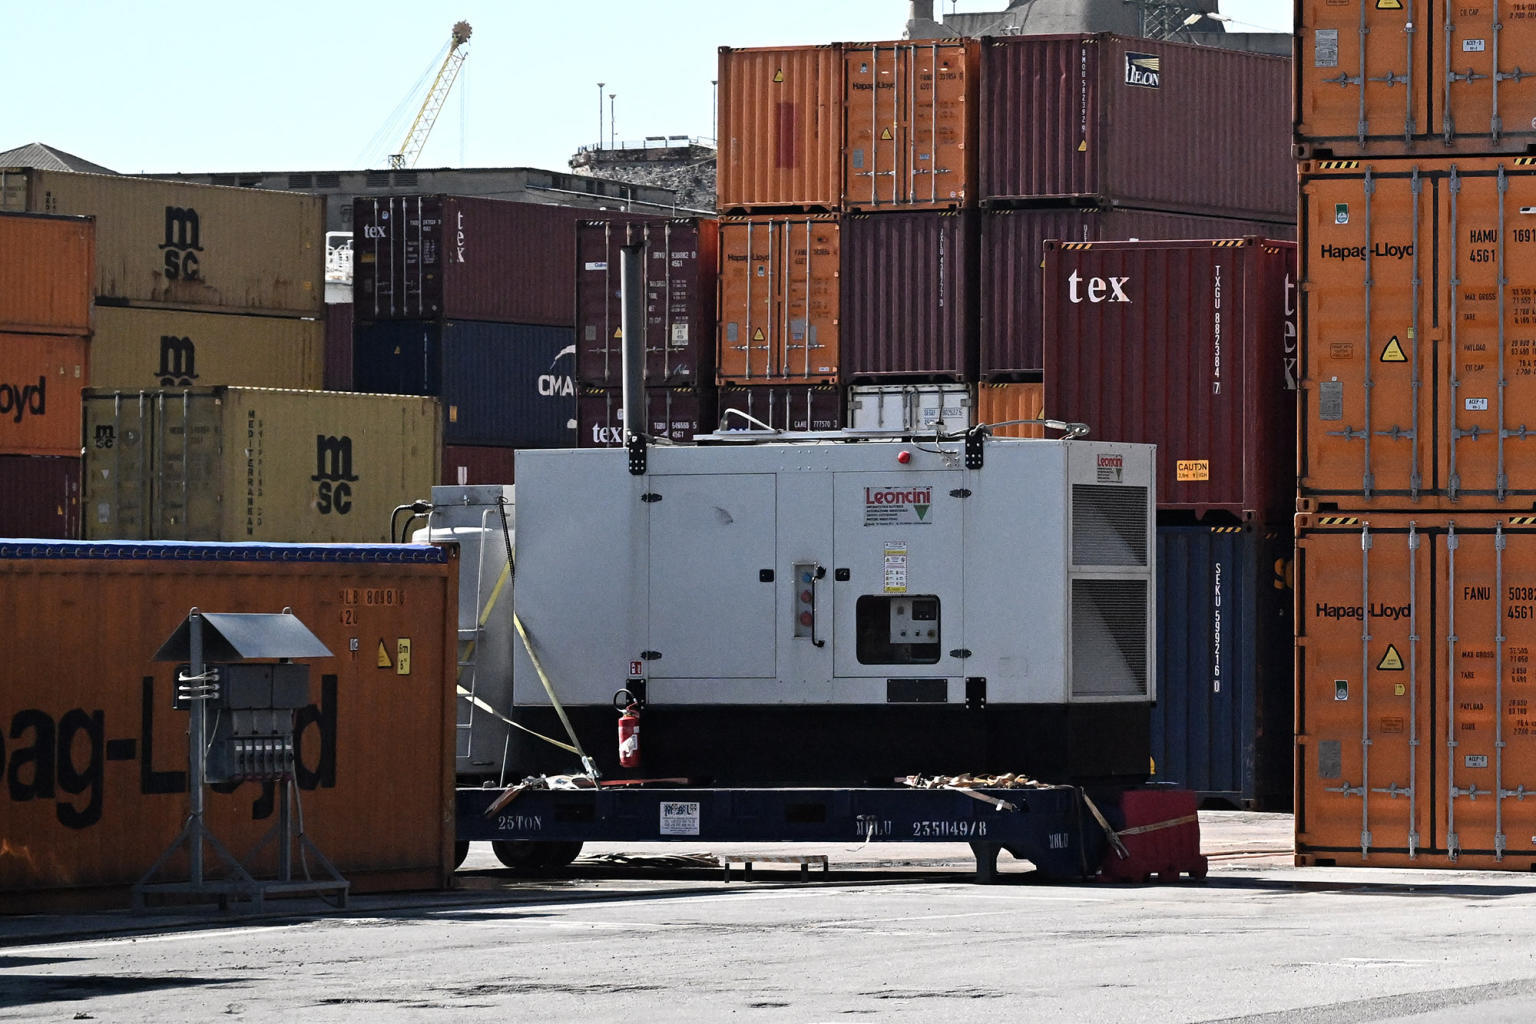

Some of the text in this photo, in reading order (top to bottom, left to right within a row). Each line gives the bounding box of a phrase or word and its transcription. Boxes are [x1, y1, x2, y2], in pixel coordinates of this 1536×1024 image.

[364, 224, 386, 238] tex
[1470, 230, 1498, 244] HAMU
[1321, 242, 1414, 261] Hapag-Lloyd
[1470, 249, 1496, 263] 45G1
[1067, 268, 1131, 303] tex
[1283, 273, 1297, 390] tex
[538, 375, 574, 396] CMA
[1213, 382, 1221, 394] 7
[0, 376, 45, 423] oyd
[593, 422, 622, 443] tex
[1097, 454, 1122, 467] Leoncini
[866, 487, 930, 504] Leoncini
[1464, 587, 1490, 600] FANU
[1316, 603, 1411, 621] Hapag-Lloyd
[1508, 606, 1534, 619] 45G1
[1213, 680, 1220, 692] 0
